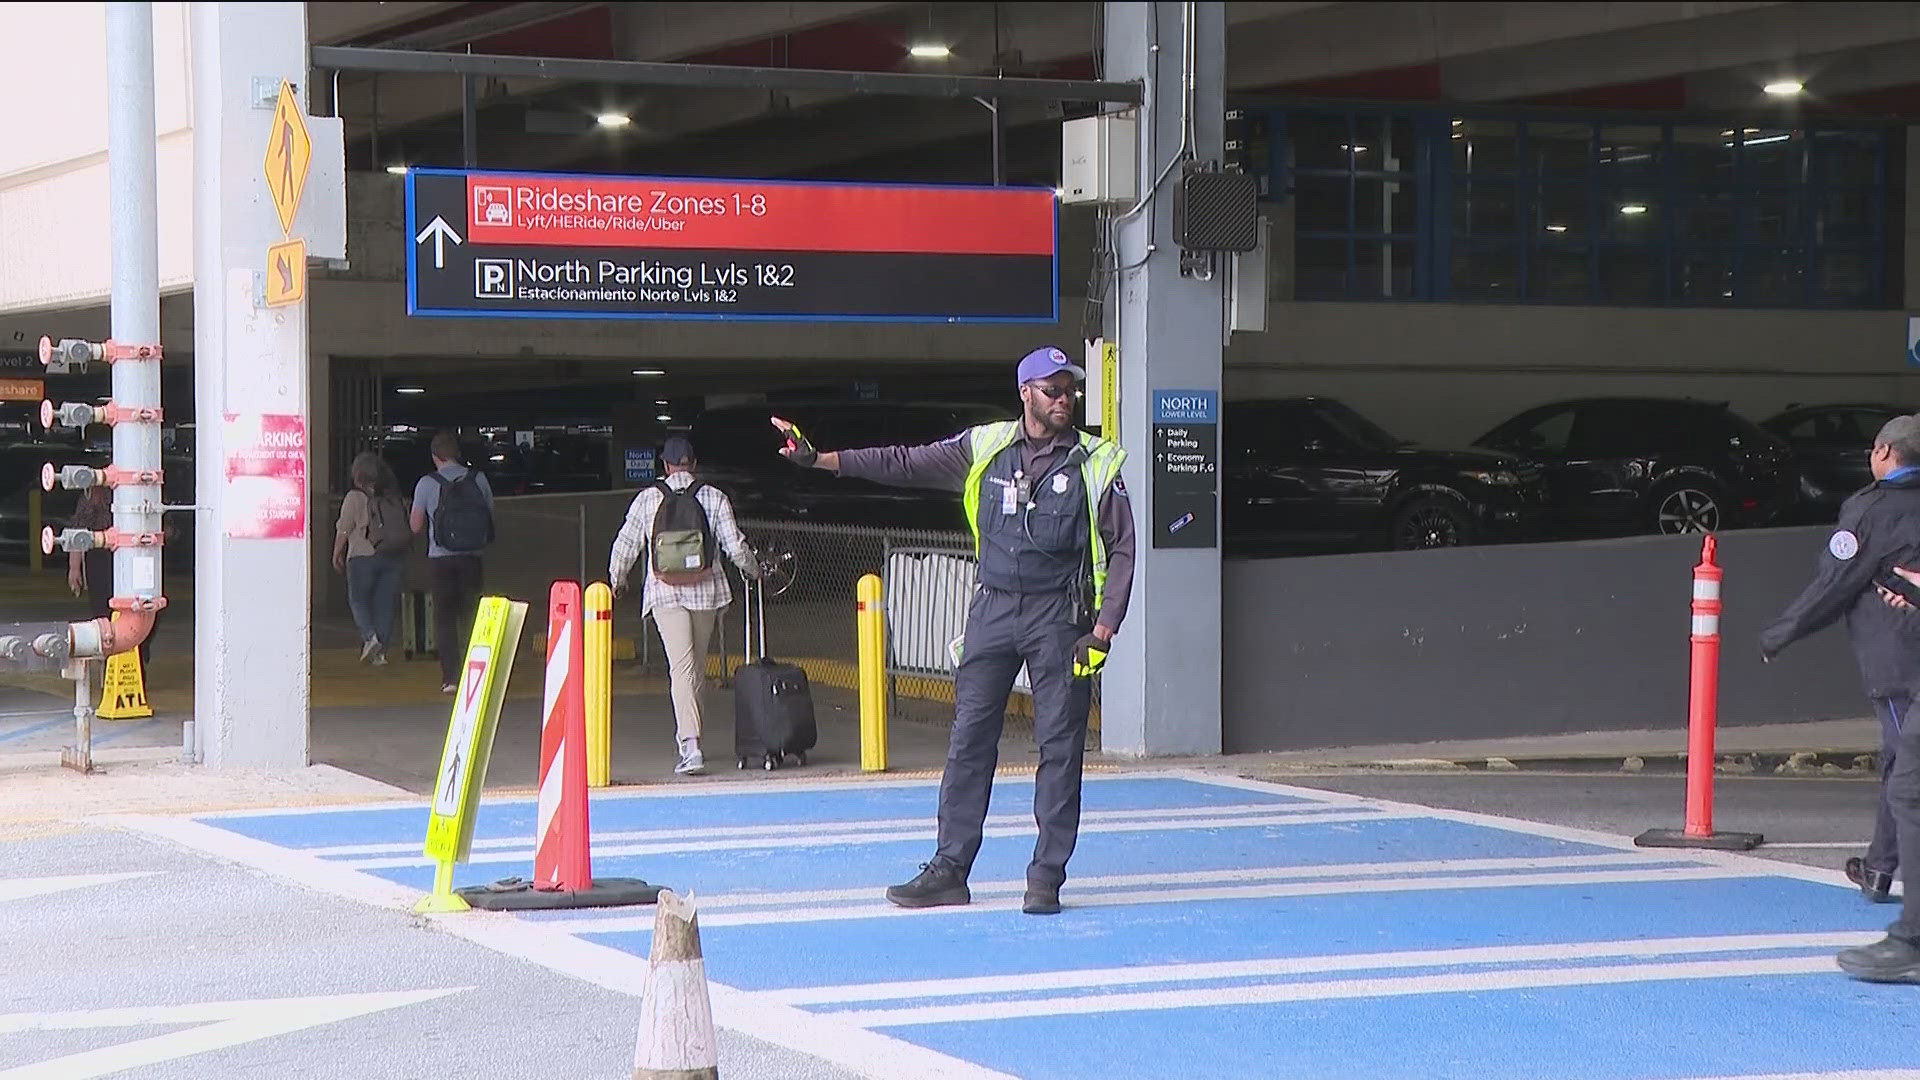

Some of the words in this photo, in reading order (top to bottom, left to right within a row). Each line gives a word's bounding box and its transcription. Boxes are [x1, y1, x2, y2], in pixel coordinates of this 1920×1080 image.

[517, 187, 643, 214] Rideshare
[650, 191, 726, 215] Zones
[732, 194, 767, 216] 1-8
[517, 214, 686, 232] Lyft/HERide/Ride/Uber
[517, 260, 590, 284] North
[599, 261, 693, 289] Parking
[701, 263, 748, 286] Lvls
[755, 264, 795, 287] 1&2
[518, 286, 636, 301] Estacionamiento
[641, 288, 680, 302] Norte
[684, 289, 711, 303] Lvls
[714, 289, 738, 303] 1&2
[25, 355, 33, 367] 2
[1161, 397, 1208, 411] NORTH
[1161, 410, 1186, 419] LOWER
[1187, 411, 1208, 419] LEVEL
[256, 431, 303, 448] ARKING
[1167, 428, 1189, 439] Daily
[1167, 439, 1199, 449] Parking
[628, 451, 652, 459] North
[1167, 453, 1206, 463] Economy
[1167, 463, 1199, 474] Parking
[116, 693, 148, 709] ATL
